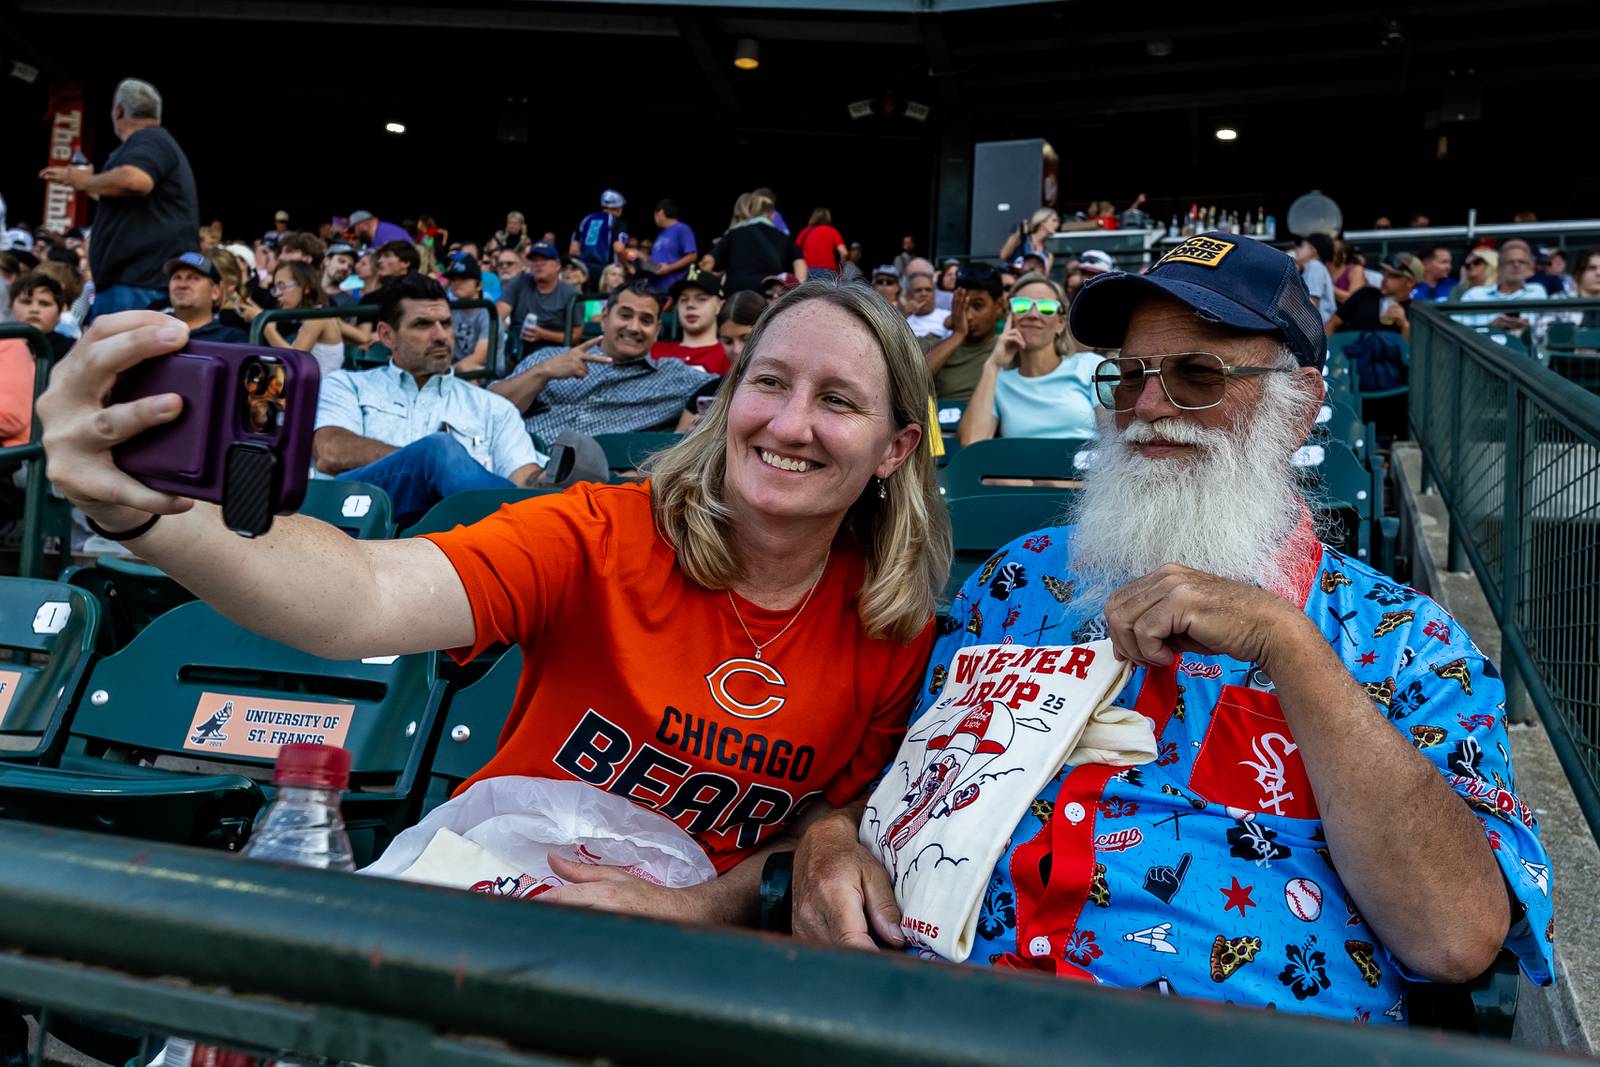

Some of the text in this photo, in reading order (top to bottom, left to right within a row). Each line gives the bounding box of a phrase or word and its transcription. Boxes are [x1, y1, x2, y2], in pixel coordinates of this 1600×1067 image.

[51, 110, 82, 160] The
[955, 646, 1097, 685] WIENER
[704, 656, 787, 720] C
[1042, 693, 1066, 711] 25
[246, 709, 340, 729] UNIVERSITY OF
[247, 729, 325, 745] ST. FRANCIS
[655, 706, 816, 783] CHICAGO
